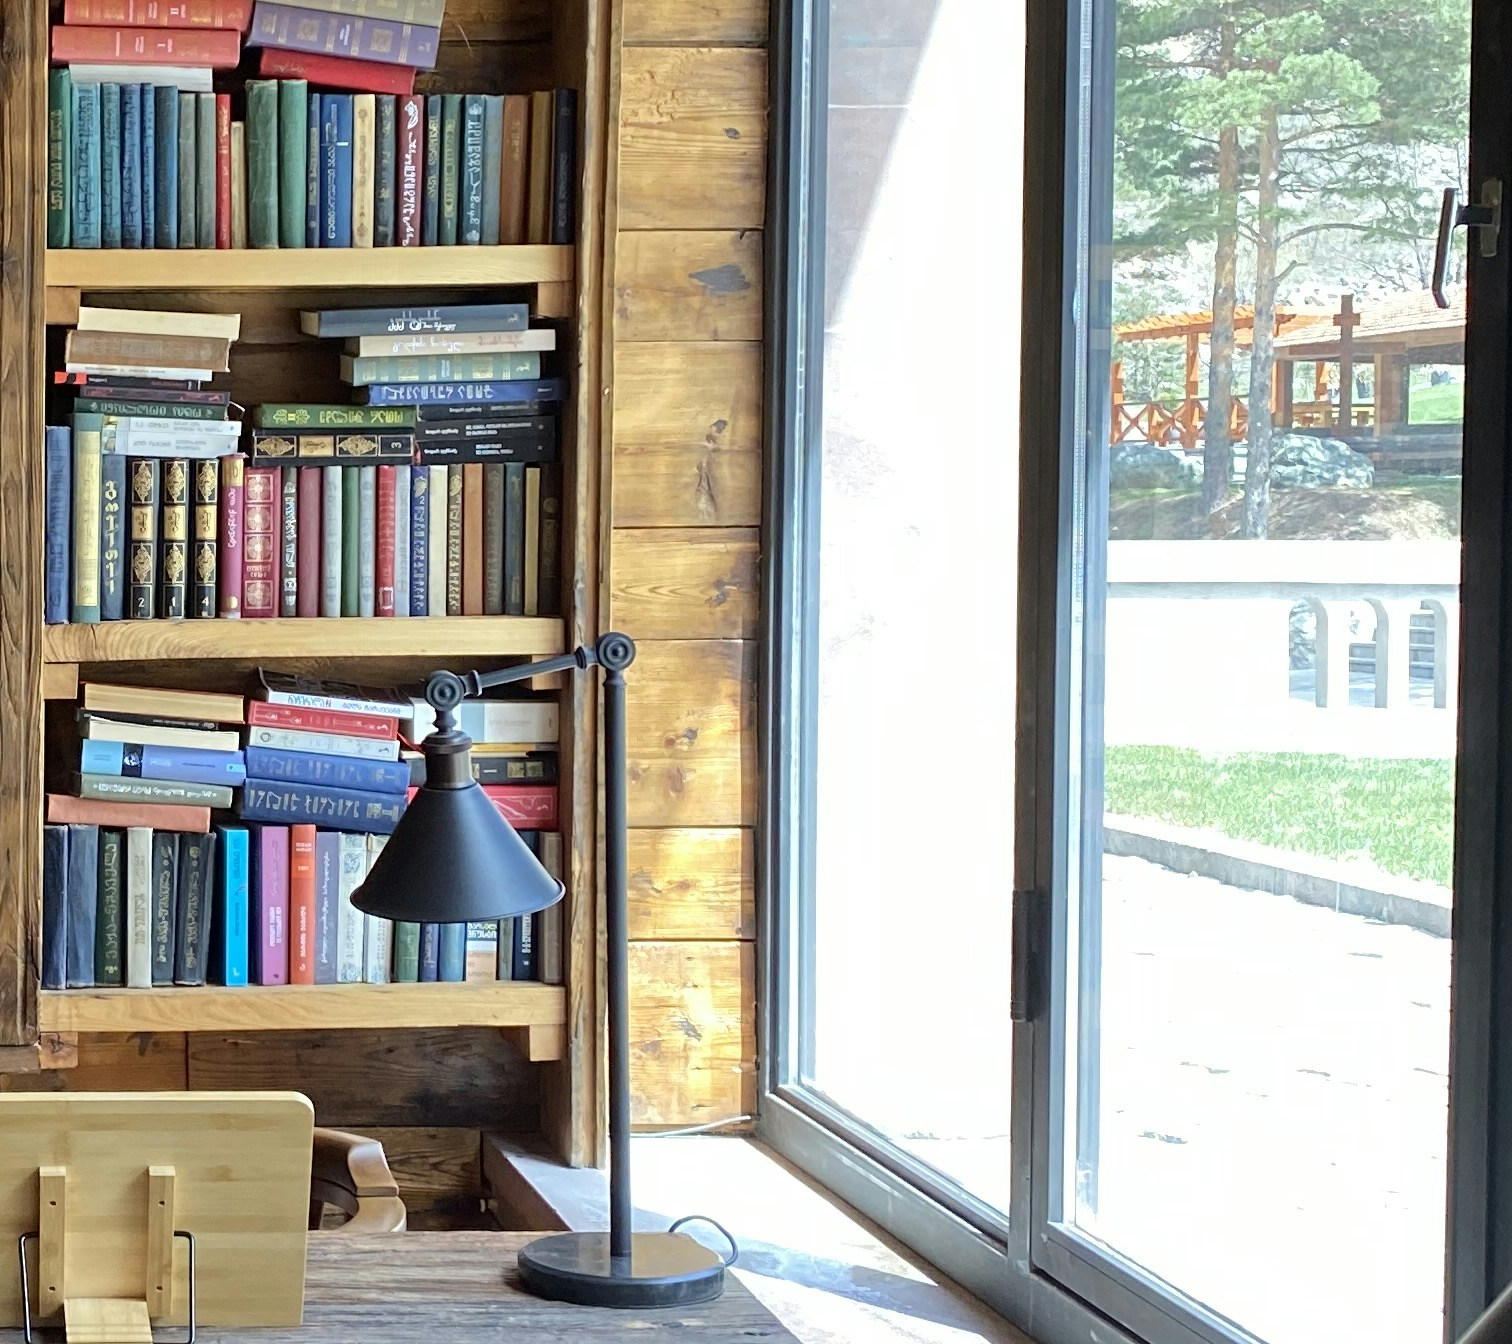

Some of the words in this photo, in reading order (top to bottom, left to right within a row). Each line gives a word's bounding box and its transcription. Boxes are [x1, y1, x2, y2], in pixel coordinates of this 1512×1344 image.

[382, 385, 454, 400] რუსთაველი
[457, 384, 494, 399] შოთა
[101, 402, 166, 416] იოსელიანი
[172, 408, 202, 418] ოტია
[319, 410, 364, 424] ჭილაძე
[369, 410, 403, 424] ოთარ
[227, 509, 238, 548] ჭავჭავაძე
[138, 597, 145, 608] 2
[171, 596, 176, 607] 1
[202, 596, 209, 607] 4
[104, 842, 118, 959] ვაჟა-ფშაველა
